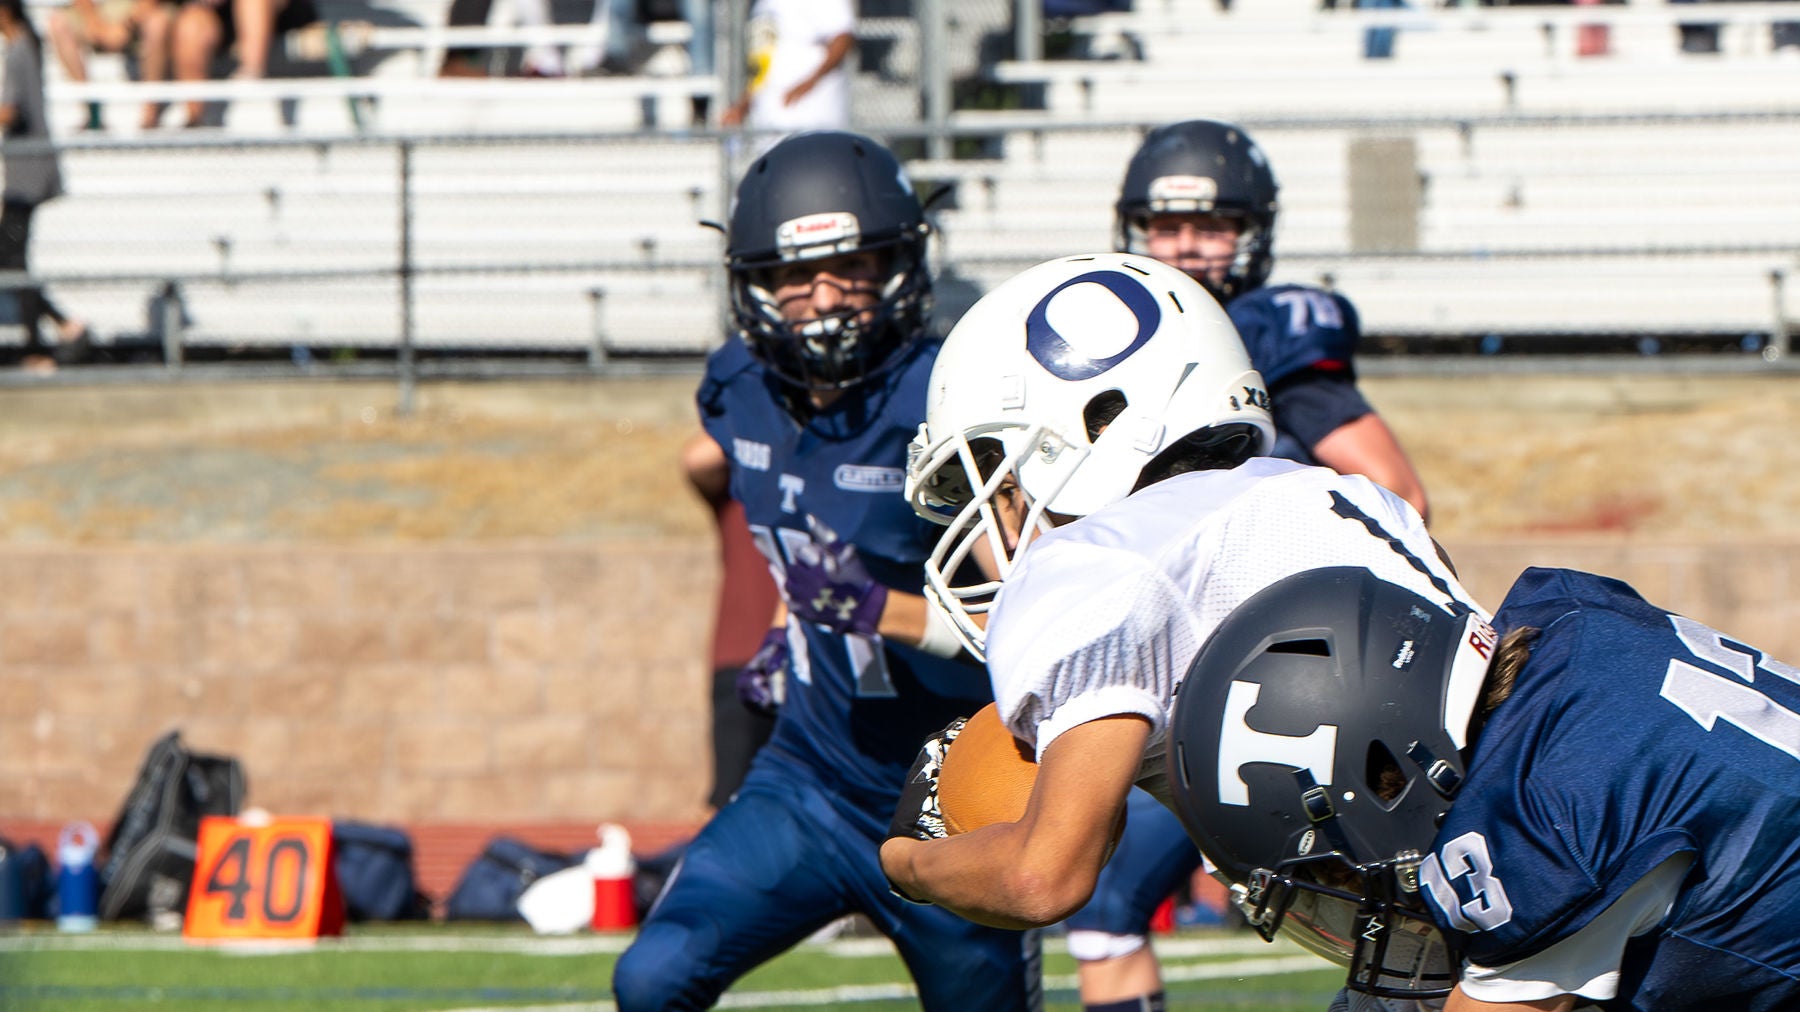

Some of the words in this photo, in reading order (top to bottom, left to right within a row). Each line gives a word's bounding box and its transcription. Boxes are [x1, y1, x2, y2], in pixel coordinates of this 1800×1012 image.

[1025, 270, 1162, 381] O
[778, 473, 804, 514] T
[1217, 680, 1338, 806] T
[207, 838, 309, 922] 40
[1418, 831, 1513, 934] 13
